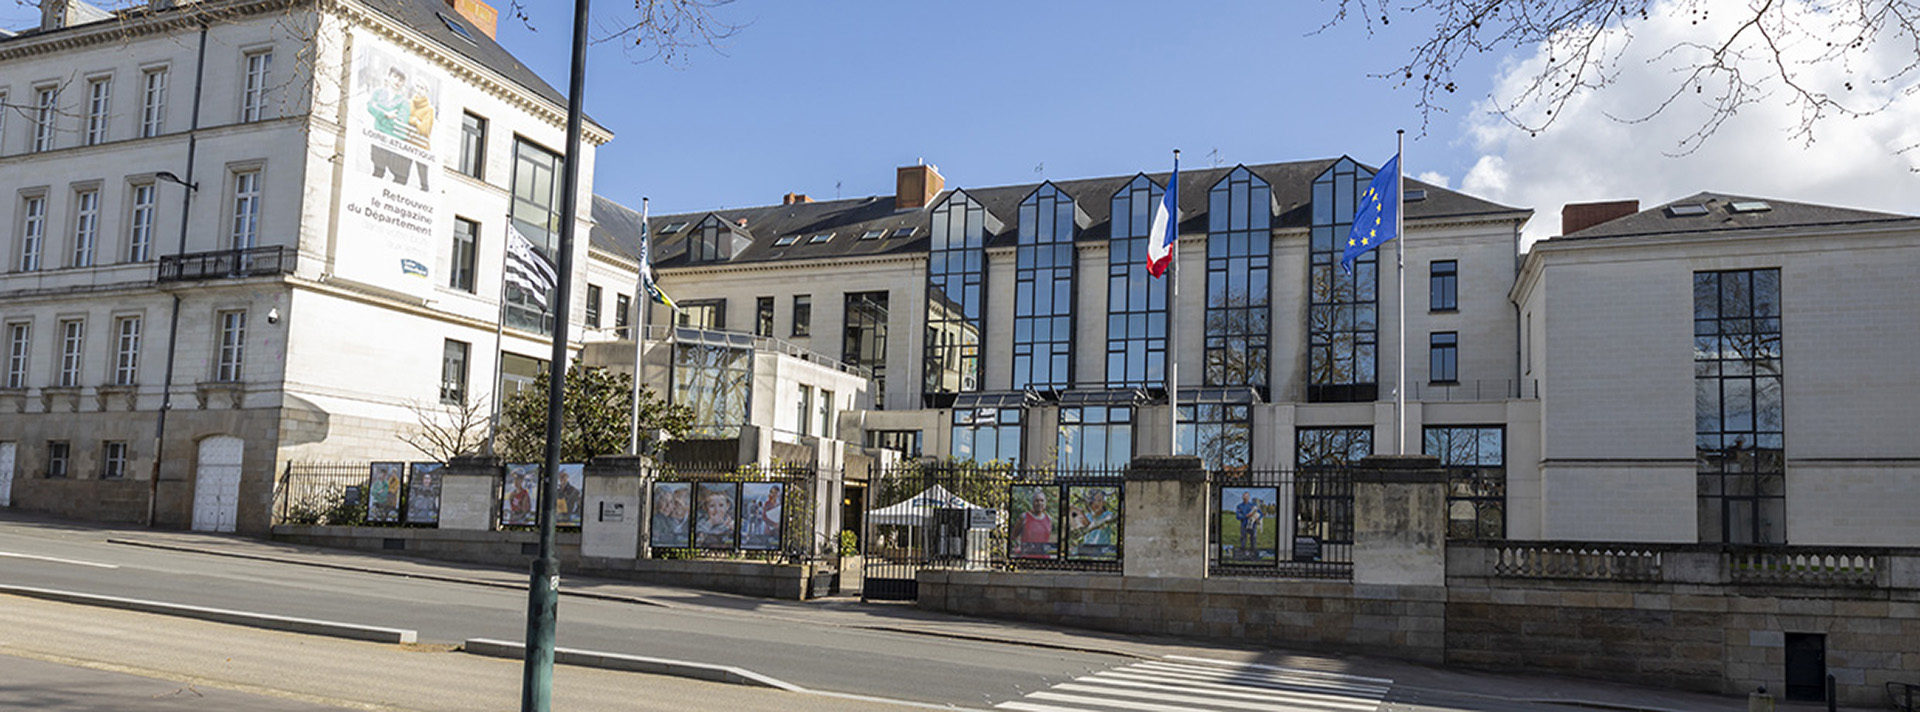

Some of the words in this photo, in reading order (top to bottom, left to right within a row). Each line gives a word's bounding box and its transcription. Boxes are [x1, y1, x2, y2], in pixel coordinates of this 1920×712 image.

[371, 197, 382, 208] le
[383, 203, 432, 225] magazine
[382, 188, 434, 214] Retrouvez
[347, 203, 361, 214] du
[364, 206, 432, 236] Département
